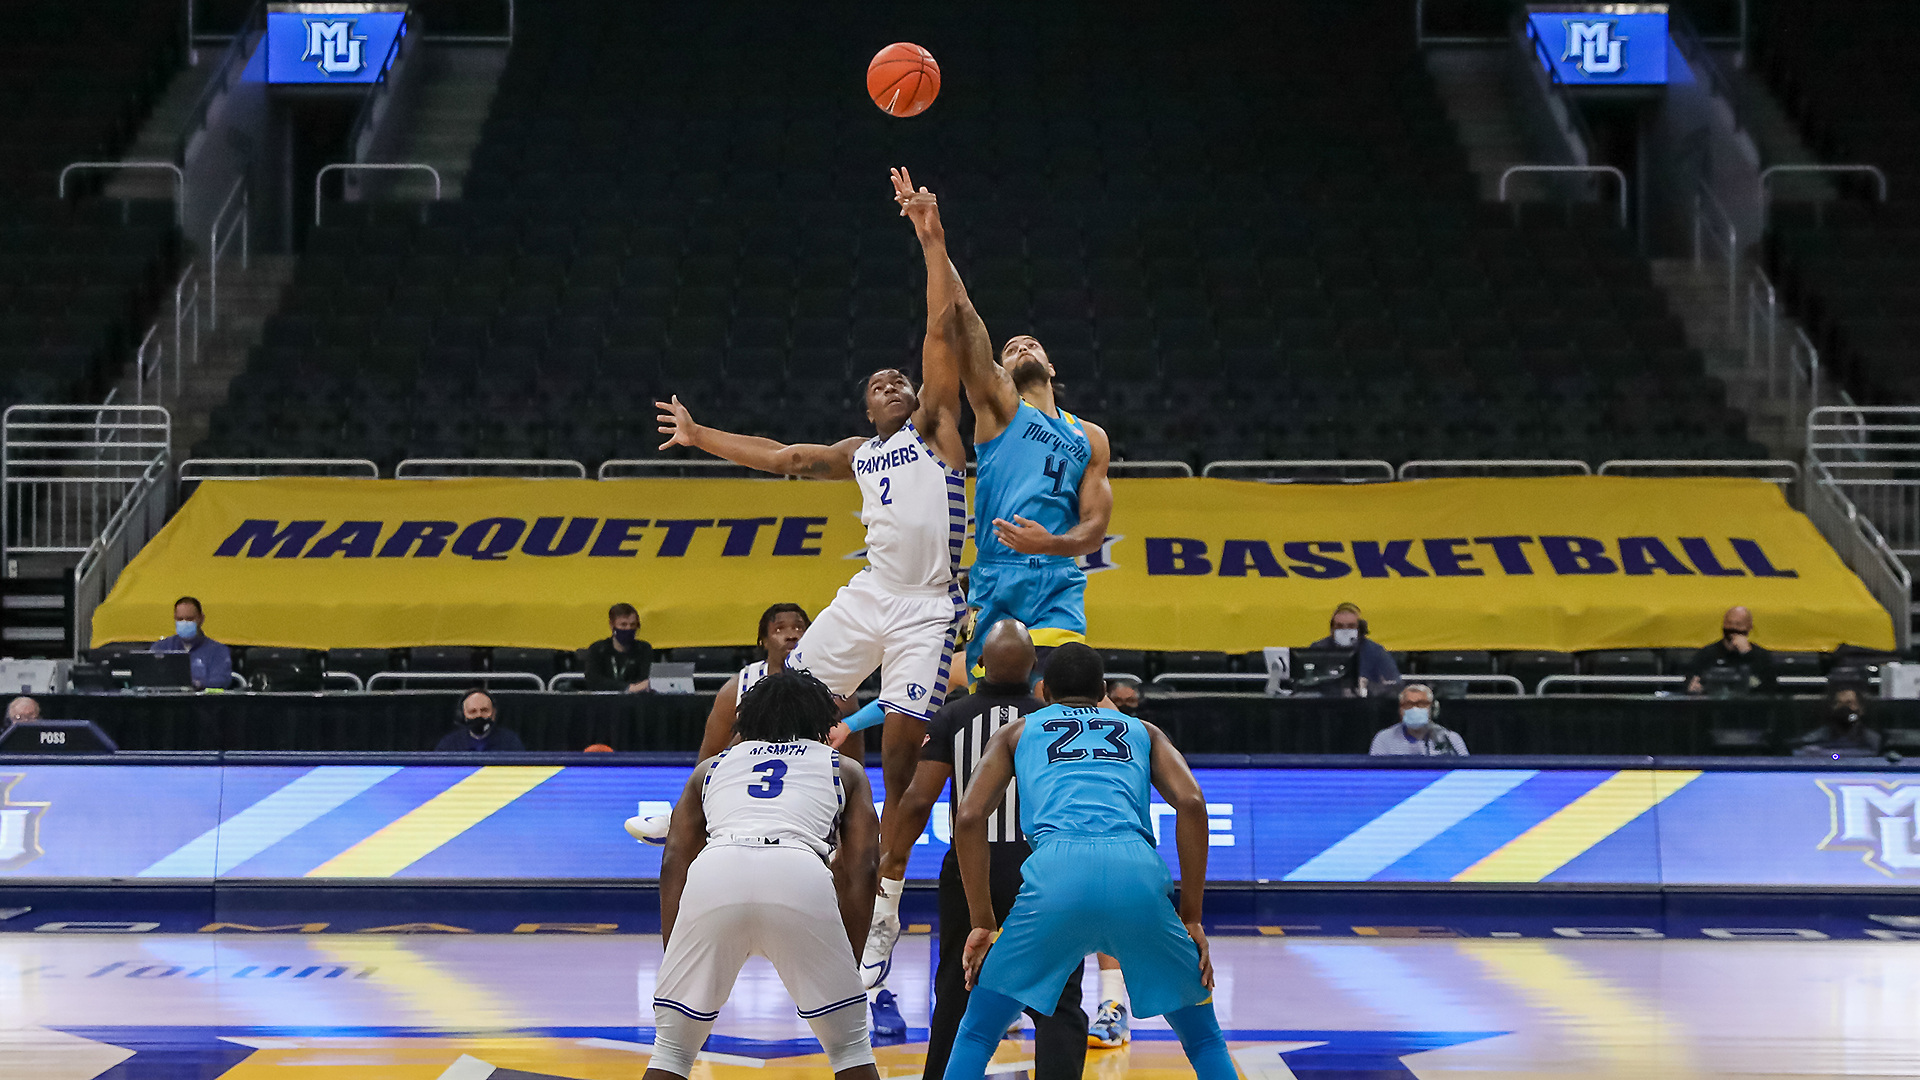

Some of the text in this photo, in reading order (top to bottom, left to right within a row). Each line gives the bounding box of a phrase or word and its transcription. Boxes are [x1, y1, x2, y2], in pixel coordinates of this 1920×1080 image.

[306, 20, 365, 74] MU
[1566, 21, 1625, 75] MU
[879, 477, 893, 506] 2
[1042, 454, 1068, 495] 4
[212, 516, 829, 561] MARQUETTE
[1145, 536, 1800, 579] BASKETBALL
[1062, 706, 1100, 717] CAIN
[1042, 718, 1134, 765] 23
[747, 759, 788, 799] 3
